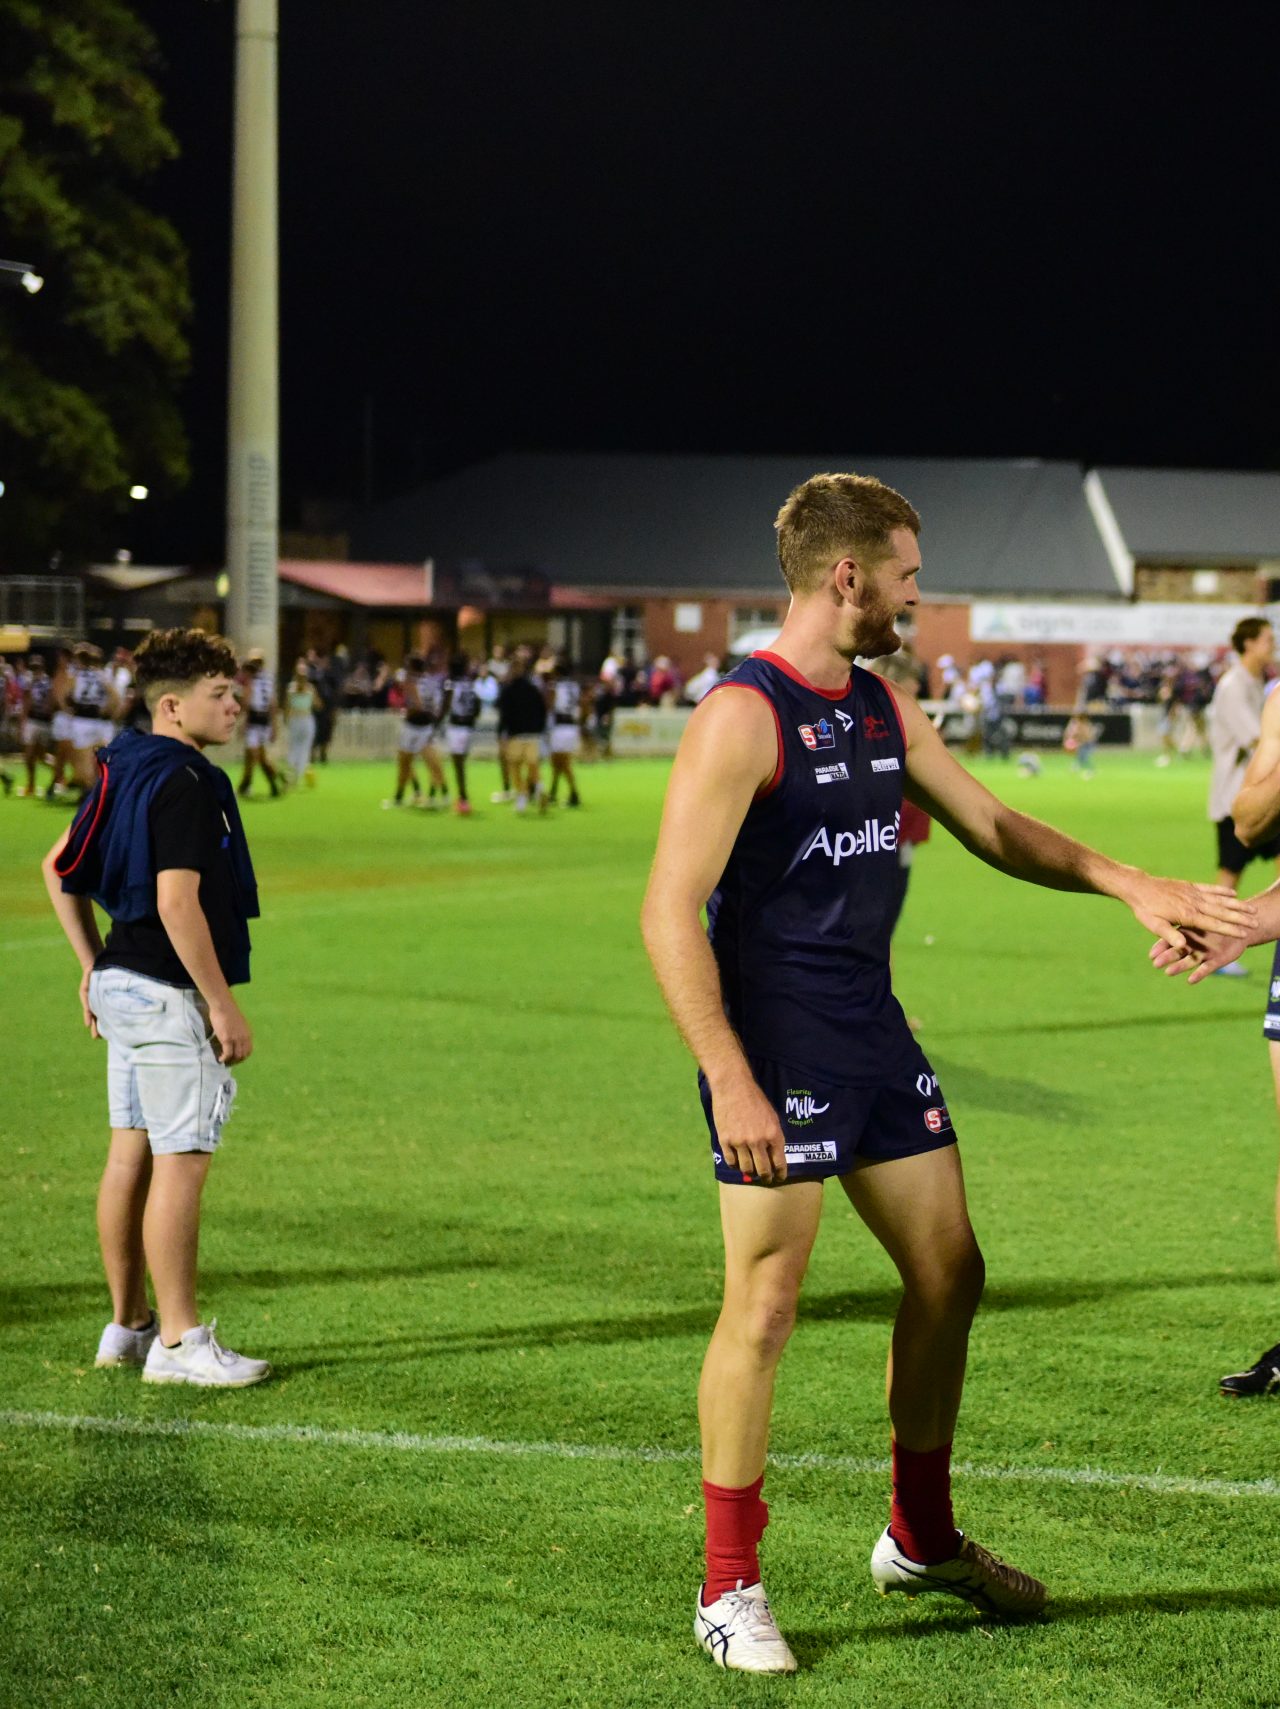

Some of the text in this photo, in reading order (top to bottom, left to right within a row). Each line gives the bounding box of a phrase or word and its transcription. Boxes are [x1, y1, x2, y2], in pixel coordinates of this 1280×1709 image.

[802, 818, 896, 866] Apelle
[786, 1096, 830, 1119] Milk
[788, 1117, 814, 1128] Company
[784, 1144, 822, 1153] PARADISE
[805, 1152, 833, 1161] MAZDA
